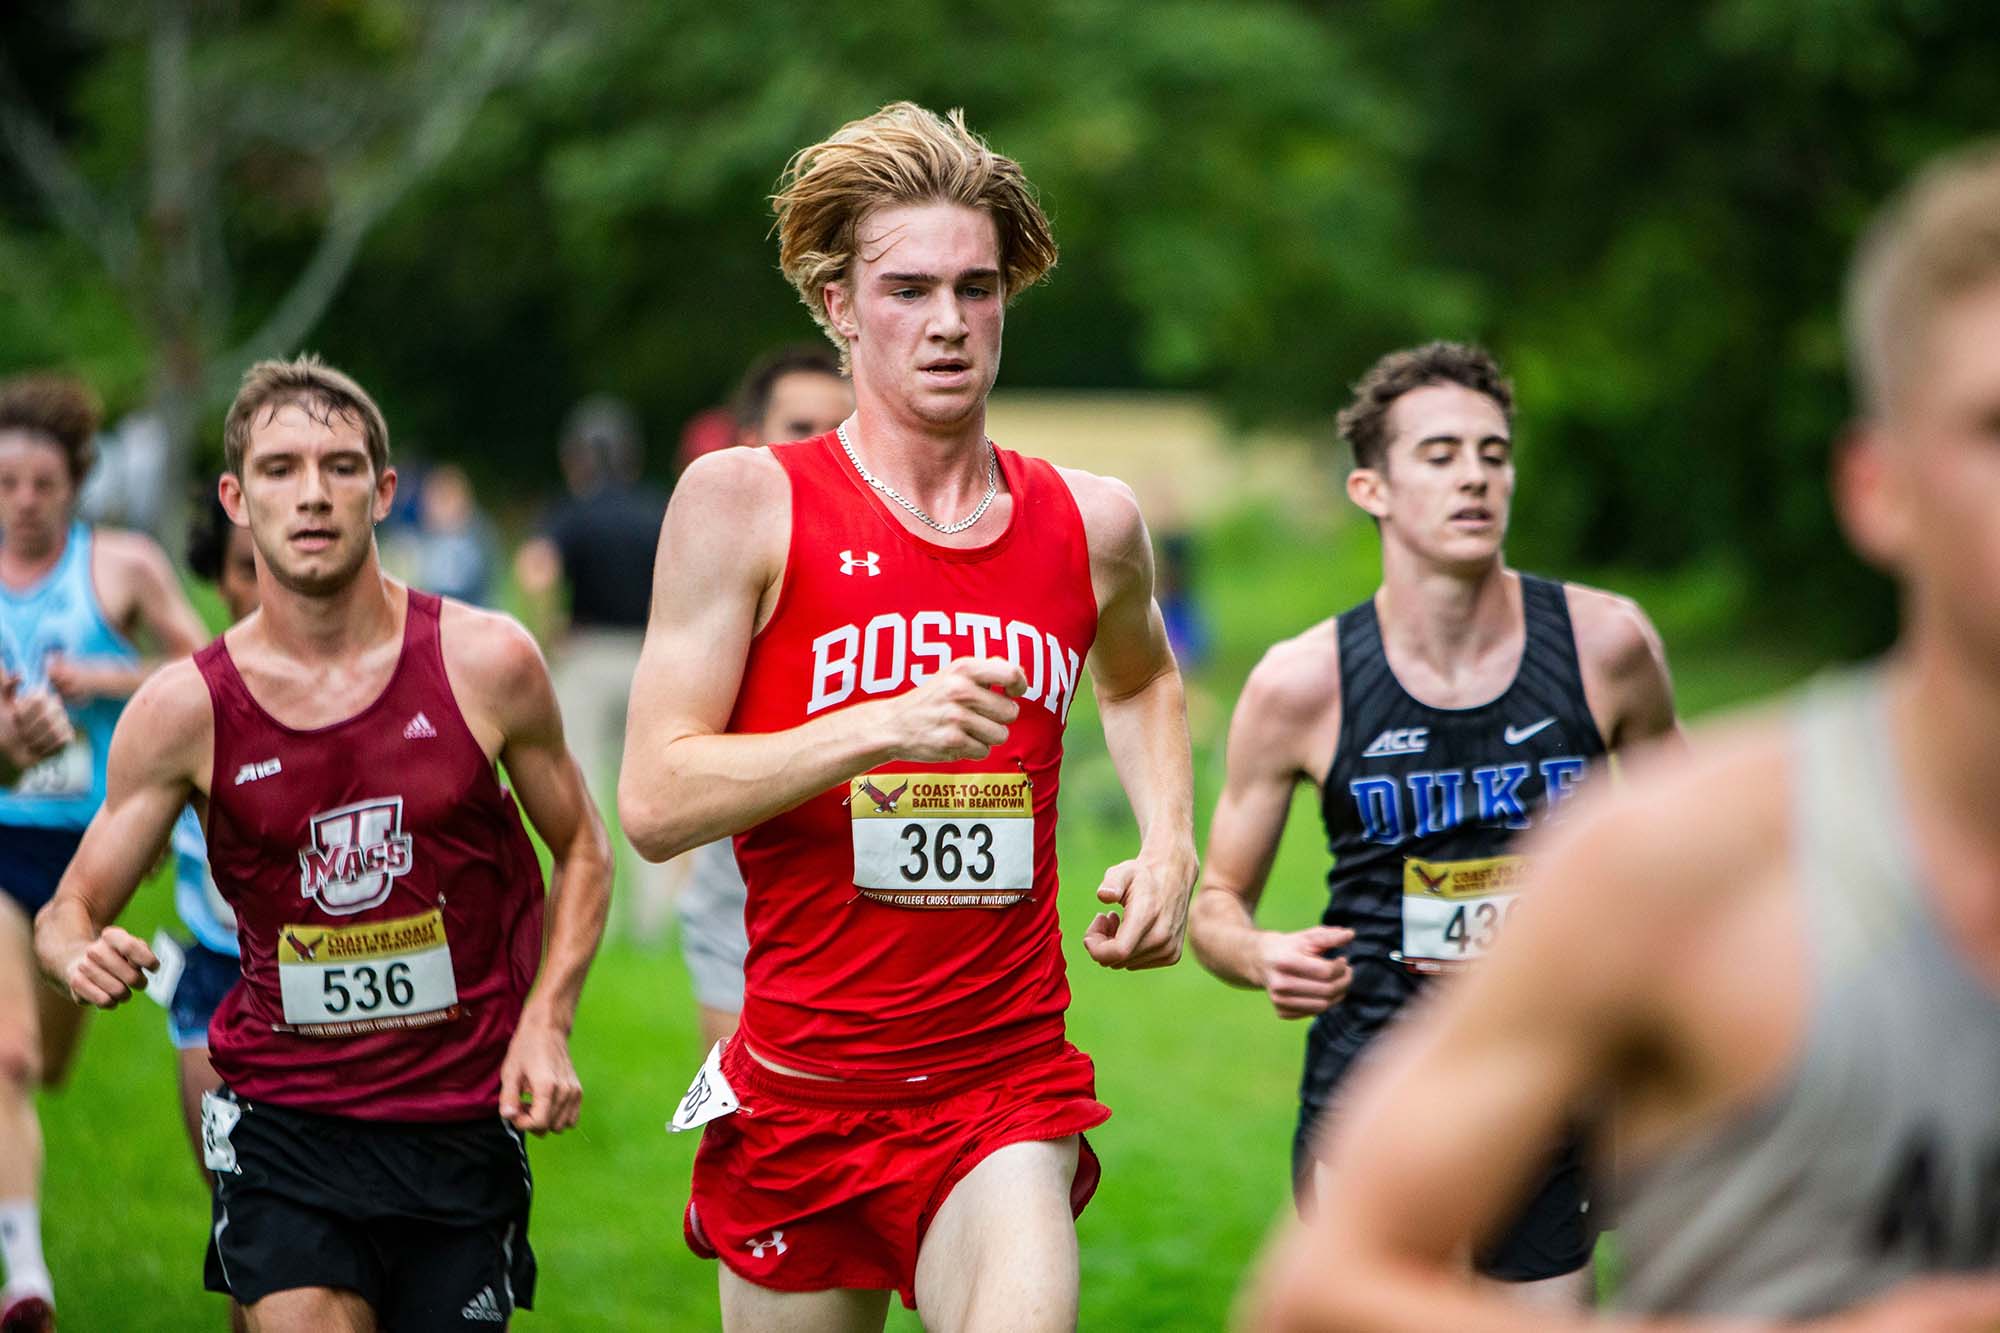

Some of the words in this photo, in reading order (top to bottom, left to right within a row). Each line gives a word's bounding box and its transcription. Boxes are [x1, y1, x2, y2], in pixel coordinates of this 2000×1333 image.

[807, 610, 1080, 722] BOSTON
[1362, 727, 1429, 757] ACC
[912, 783, 1024, 798] COAST-TO-COAST
[912, 798, 950, 809] BATTLE
[953, 798, 965, 809] IN
[969, 797, 1025, 809] BEANTOWN
[1351, 756, 1586, 845] DUKE
[900, 823, 996, 883] 363
[894, 895, 926, 906] COLLEGE
[926, 895, 949, 906] CROSS
[950, 895, 981, 906] COUNTRY
[323, 962, 414, 1014] 536
